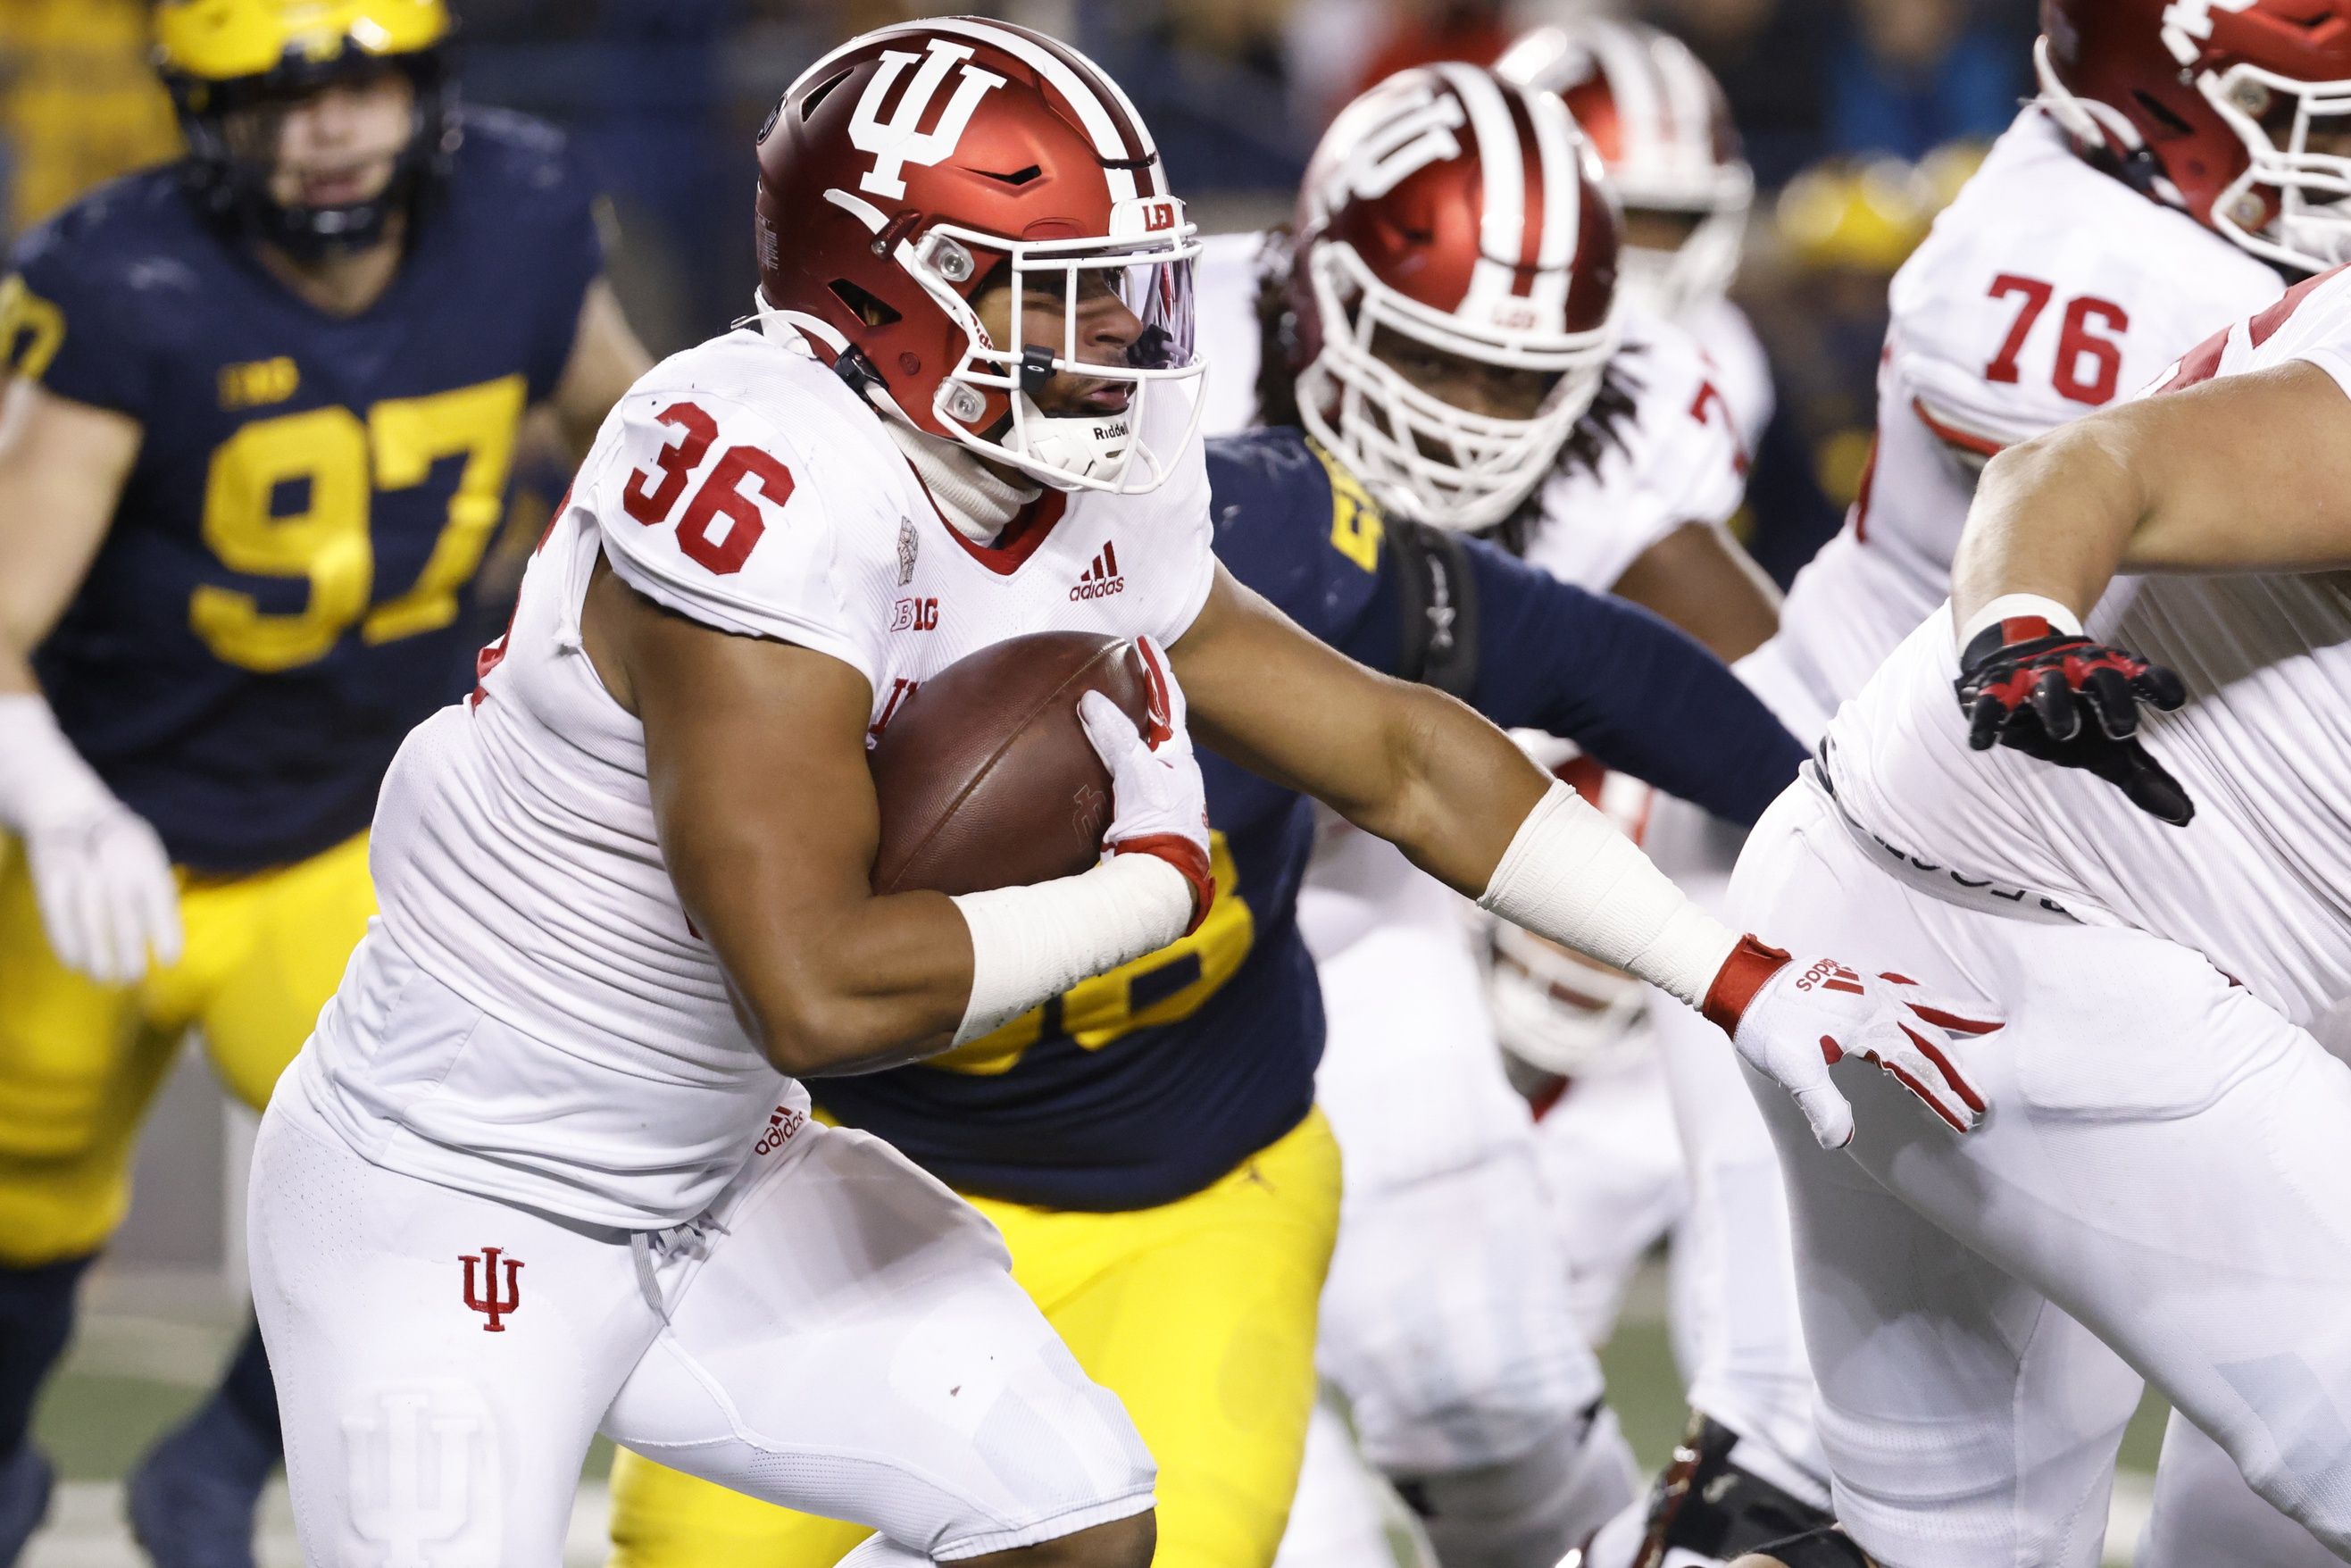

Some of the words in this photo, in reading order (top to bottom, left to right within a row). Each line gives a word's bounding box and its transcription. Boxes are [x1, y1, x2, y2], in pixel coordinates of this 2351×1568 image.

[1984, 273, 2130, 407] 76
[189, 370, 529, 675] 97
[622, 401, 796, 576] 36
[1069, 576, 1125, 602] adidas
